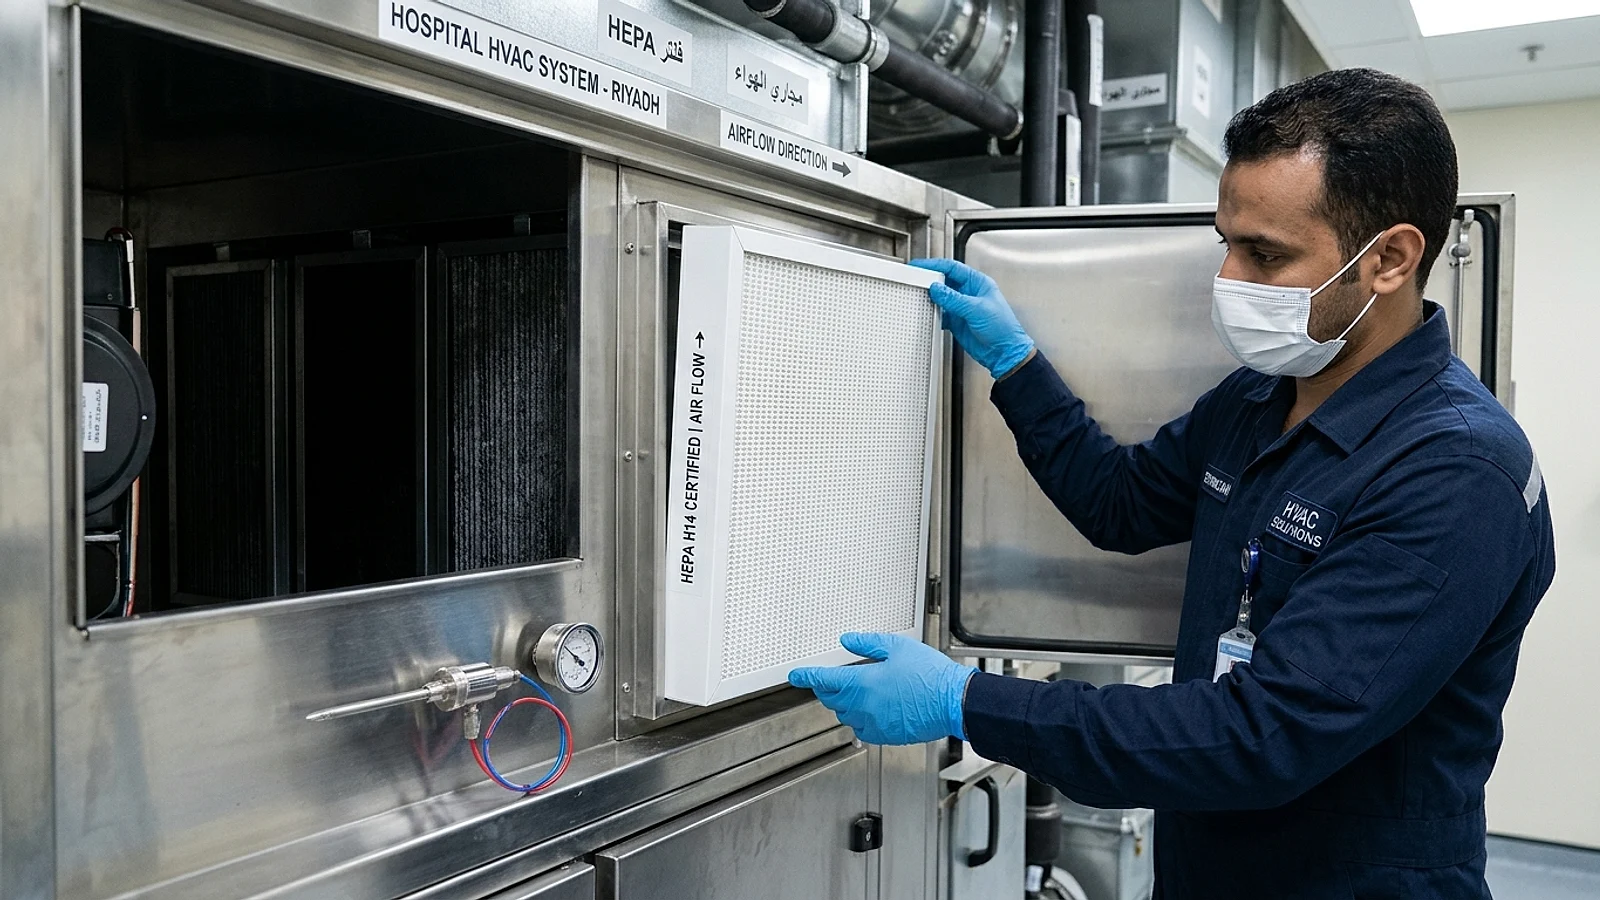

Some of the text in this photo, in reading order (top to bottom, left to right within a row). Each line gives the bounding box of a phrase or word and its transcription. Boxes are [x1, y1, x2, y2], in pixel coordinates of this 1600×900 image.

[608, 13, 656, 56] HEPA
[391, 2, 484, 56] HOSPITAL
[488, 36, 534, 73] HVAC
[538, 55, 599, 95] SYSTEM
[612, 79, 660, 116] RIYADH
[734, 64, 803, 107] مجاري الهواء
[727, 123, 829, 171] AIRFLOW DIRECTION
[691, 352, 706, 396] FLOW
[689, 398, 703, 424] AIR
[684, 436, 701, 511] CERTIFIED
[682, 515, 697, 542] H14
[1281, 500, 1320, 529] HVAC
[681, 545, 695, 584] HEPA
